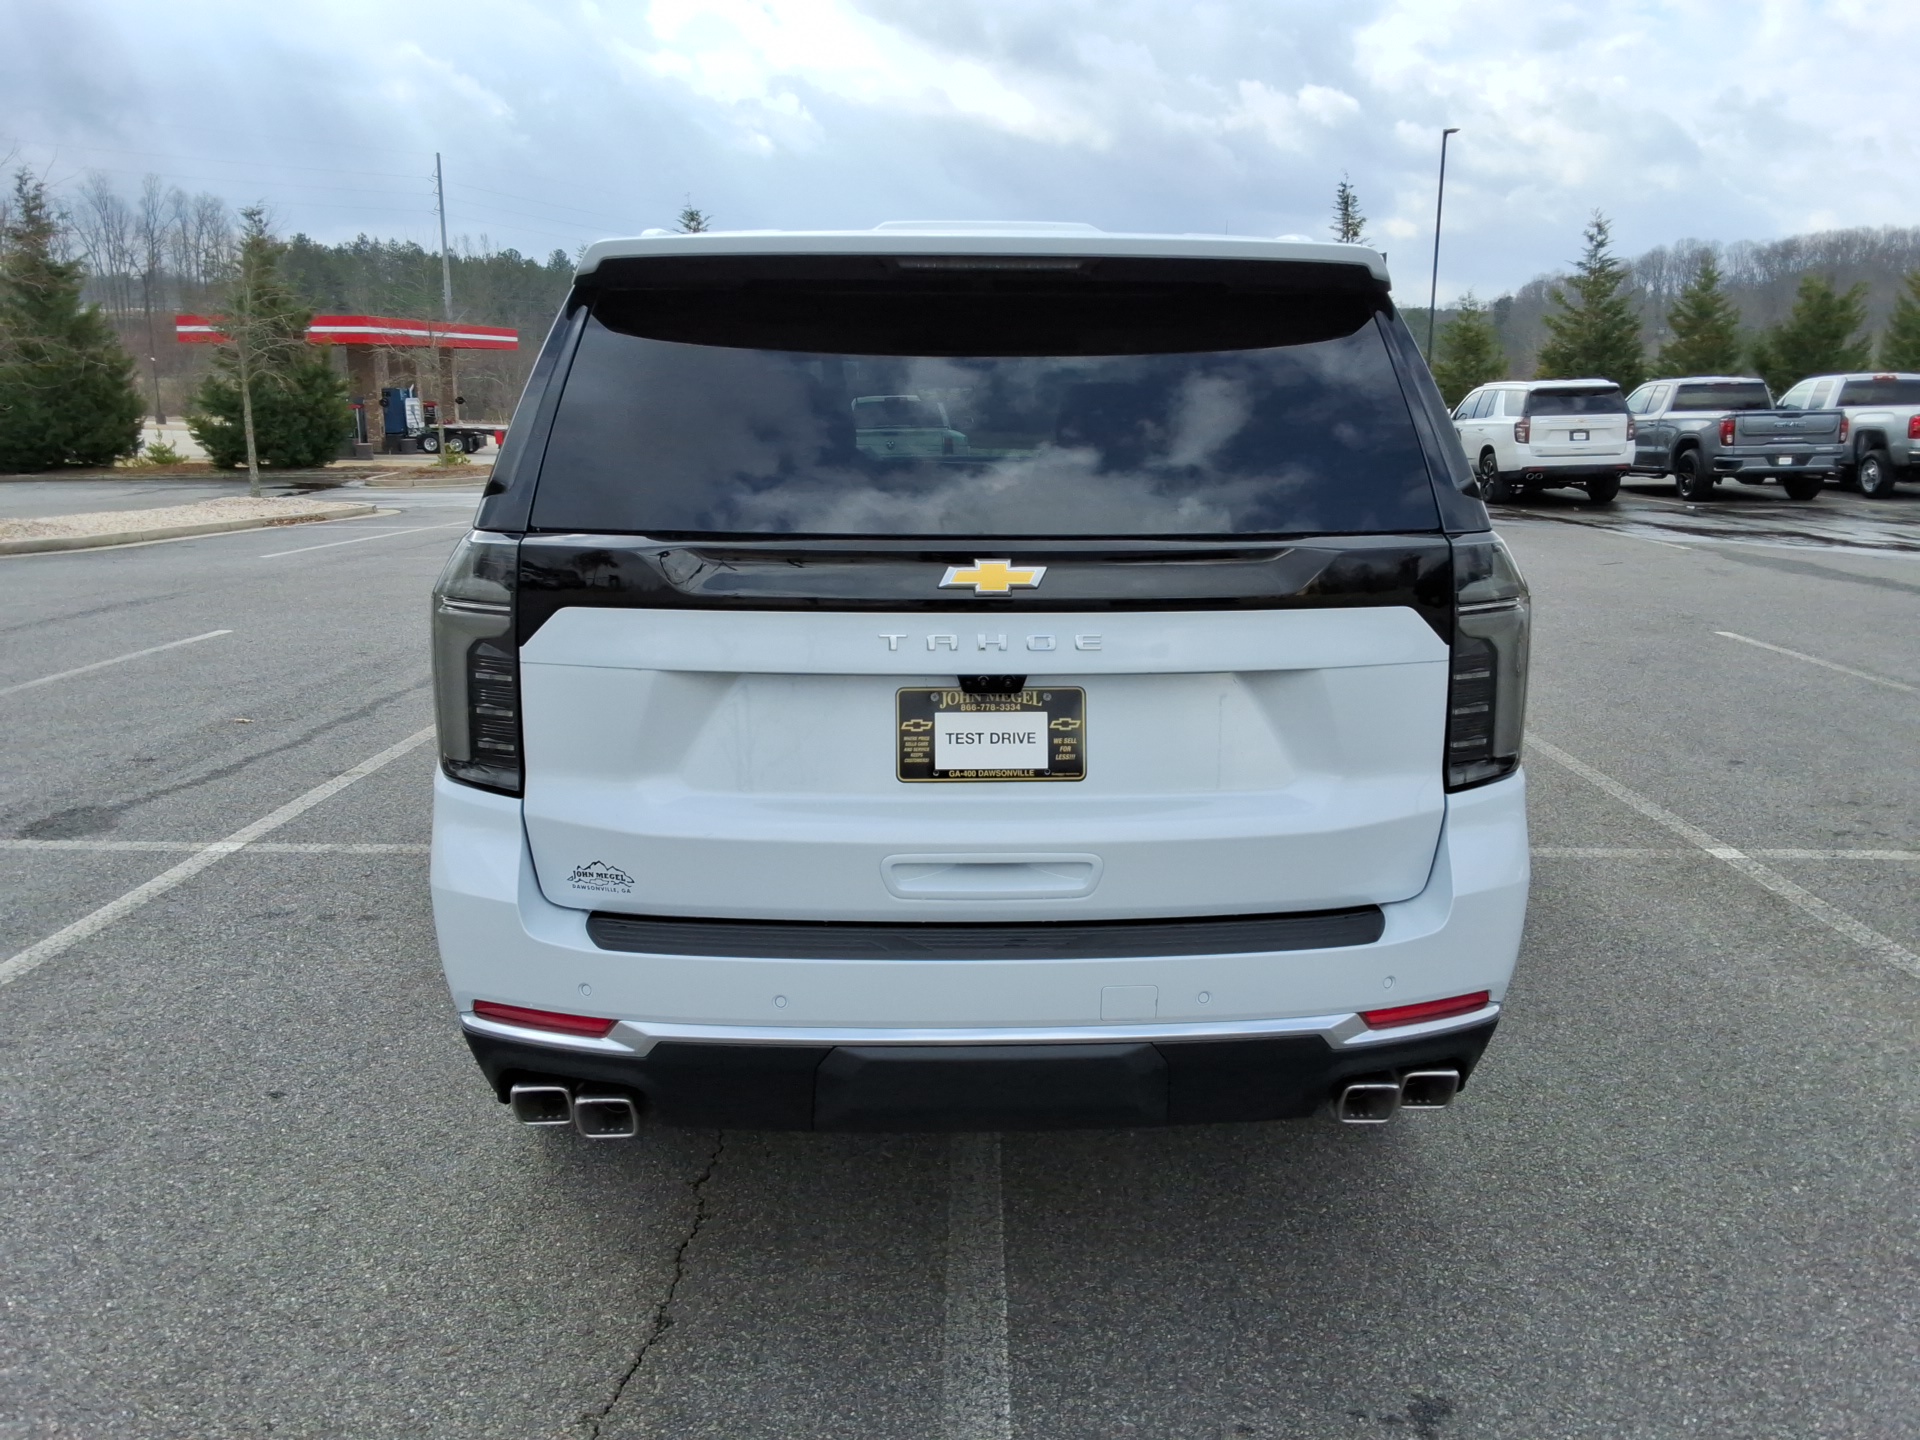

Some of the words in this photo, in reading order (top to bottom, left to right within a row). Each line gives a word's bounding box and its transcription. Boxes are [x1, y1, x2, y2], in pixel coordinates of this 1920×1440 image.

[878, 633, 1102, 652] TAHOE
[939, 691, 982, 709] JOHN
[985, 691, 1043, 707] MEGEL
[960, 703, 1021, 712] 866-778-3334
[945, 732, 985, 745] TEST
[990, 732, 1036, 744] DRIVE
[978, 769, 1035, 777] DAWSONVILLE
[573, 870, 594, 880] JOHN
[596, 872, 626, 882] MEGEL
[572, 884, 620, 894] DAWSONVILLE,
